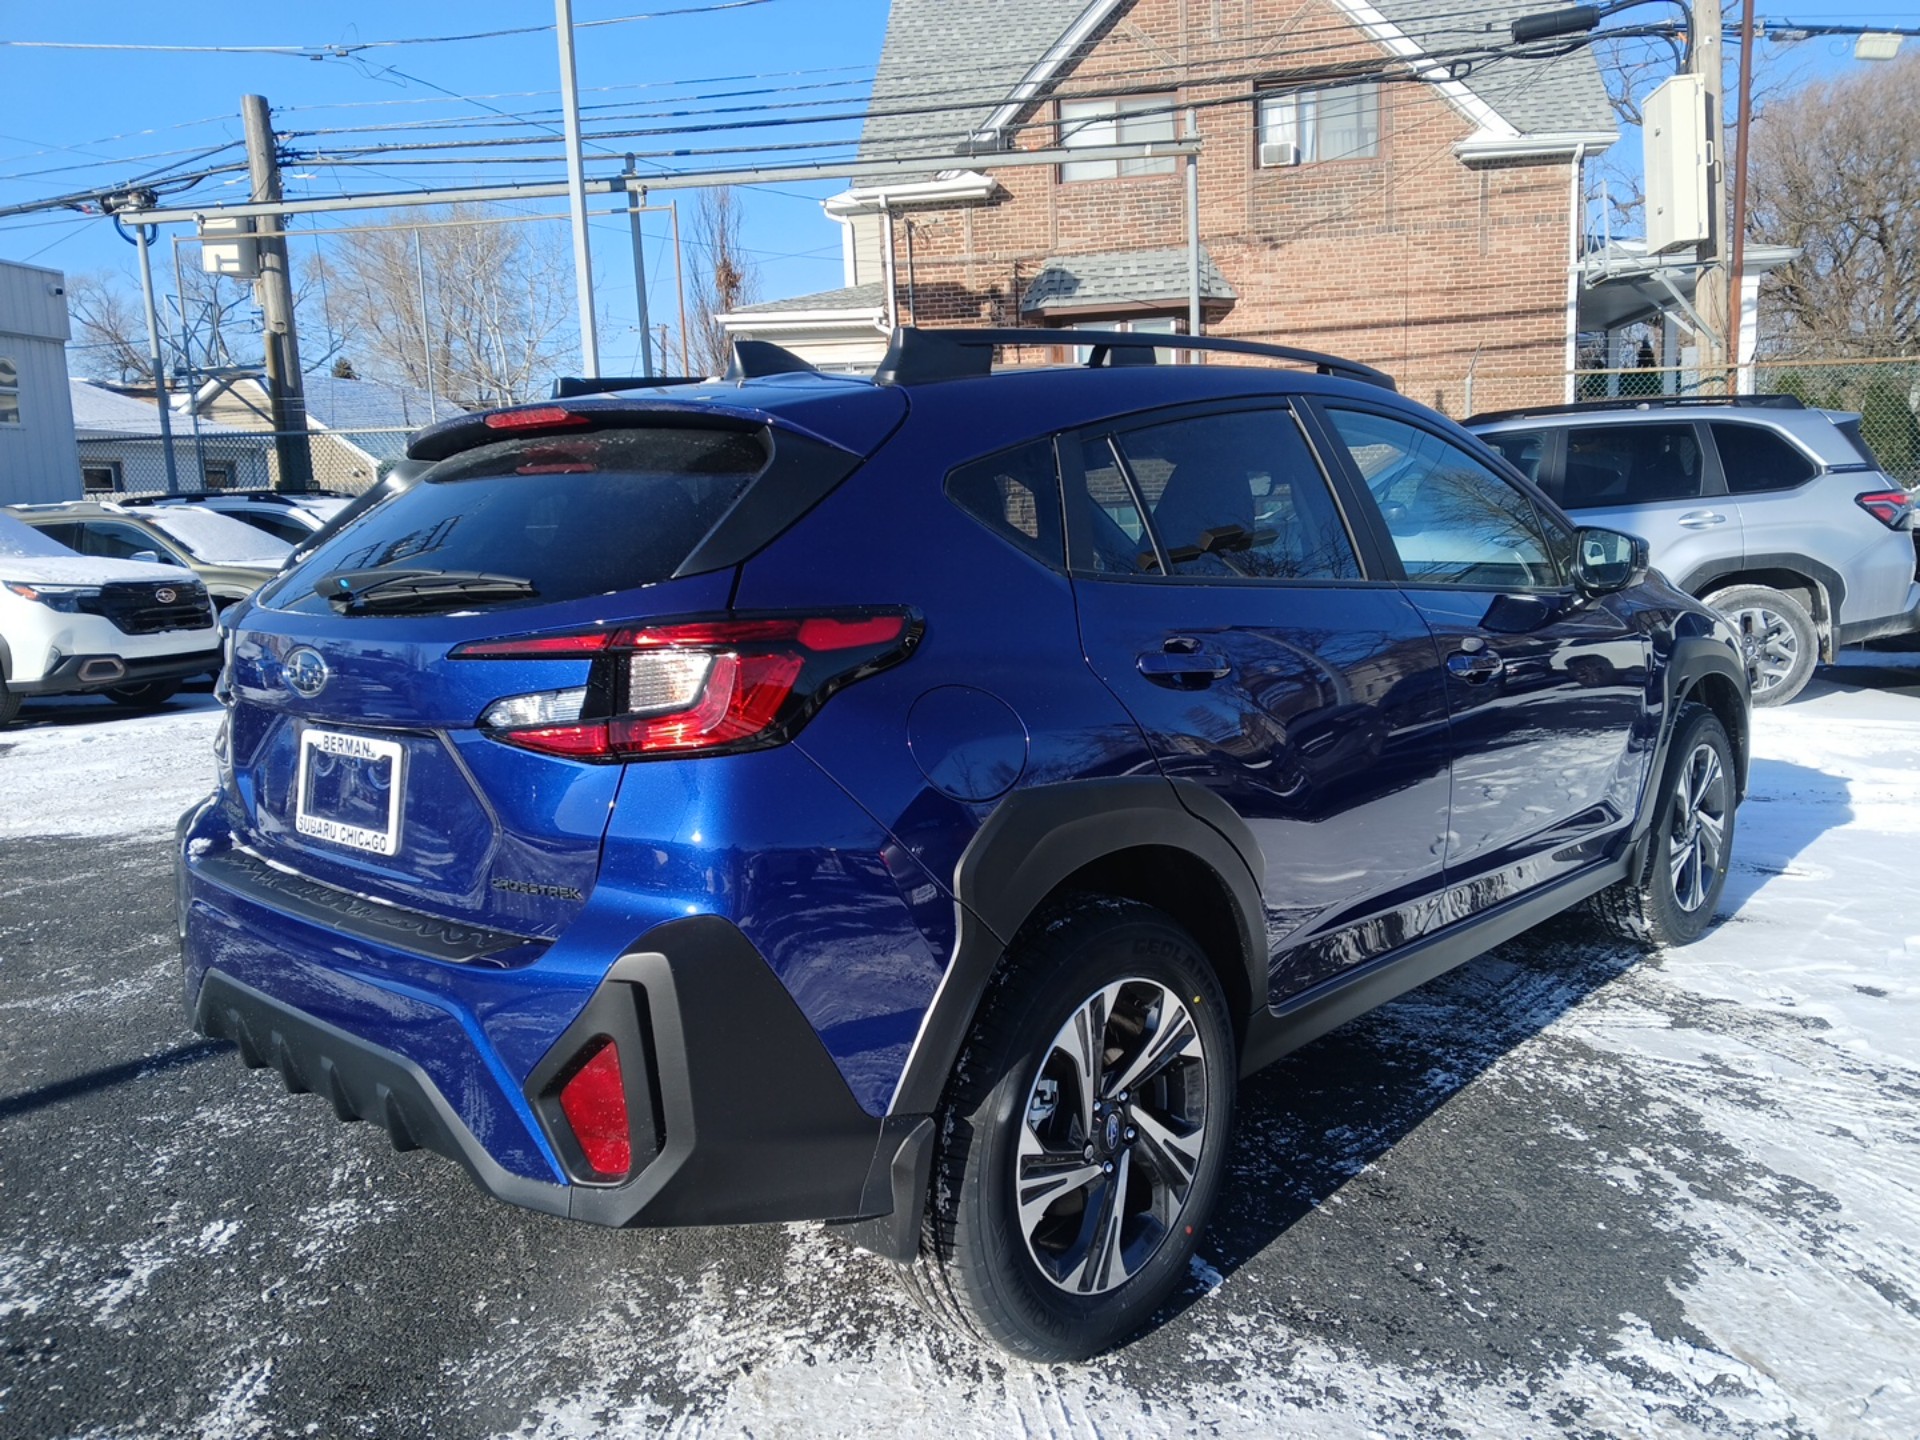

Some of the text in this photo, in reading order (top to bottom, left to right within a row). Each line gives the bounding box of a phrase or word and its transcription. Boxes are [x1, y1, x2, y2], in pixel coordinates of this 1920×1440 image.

[323, 735, 370, 757] BERMAN
[298, 816, 388, 852] SUBARU CHICAGO
[491, 879, 584, 901] CROSSTREK
